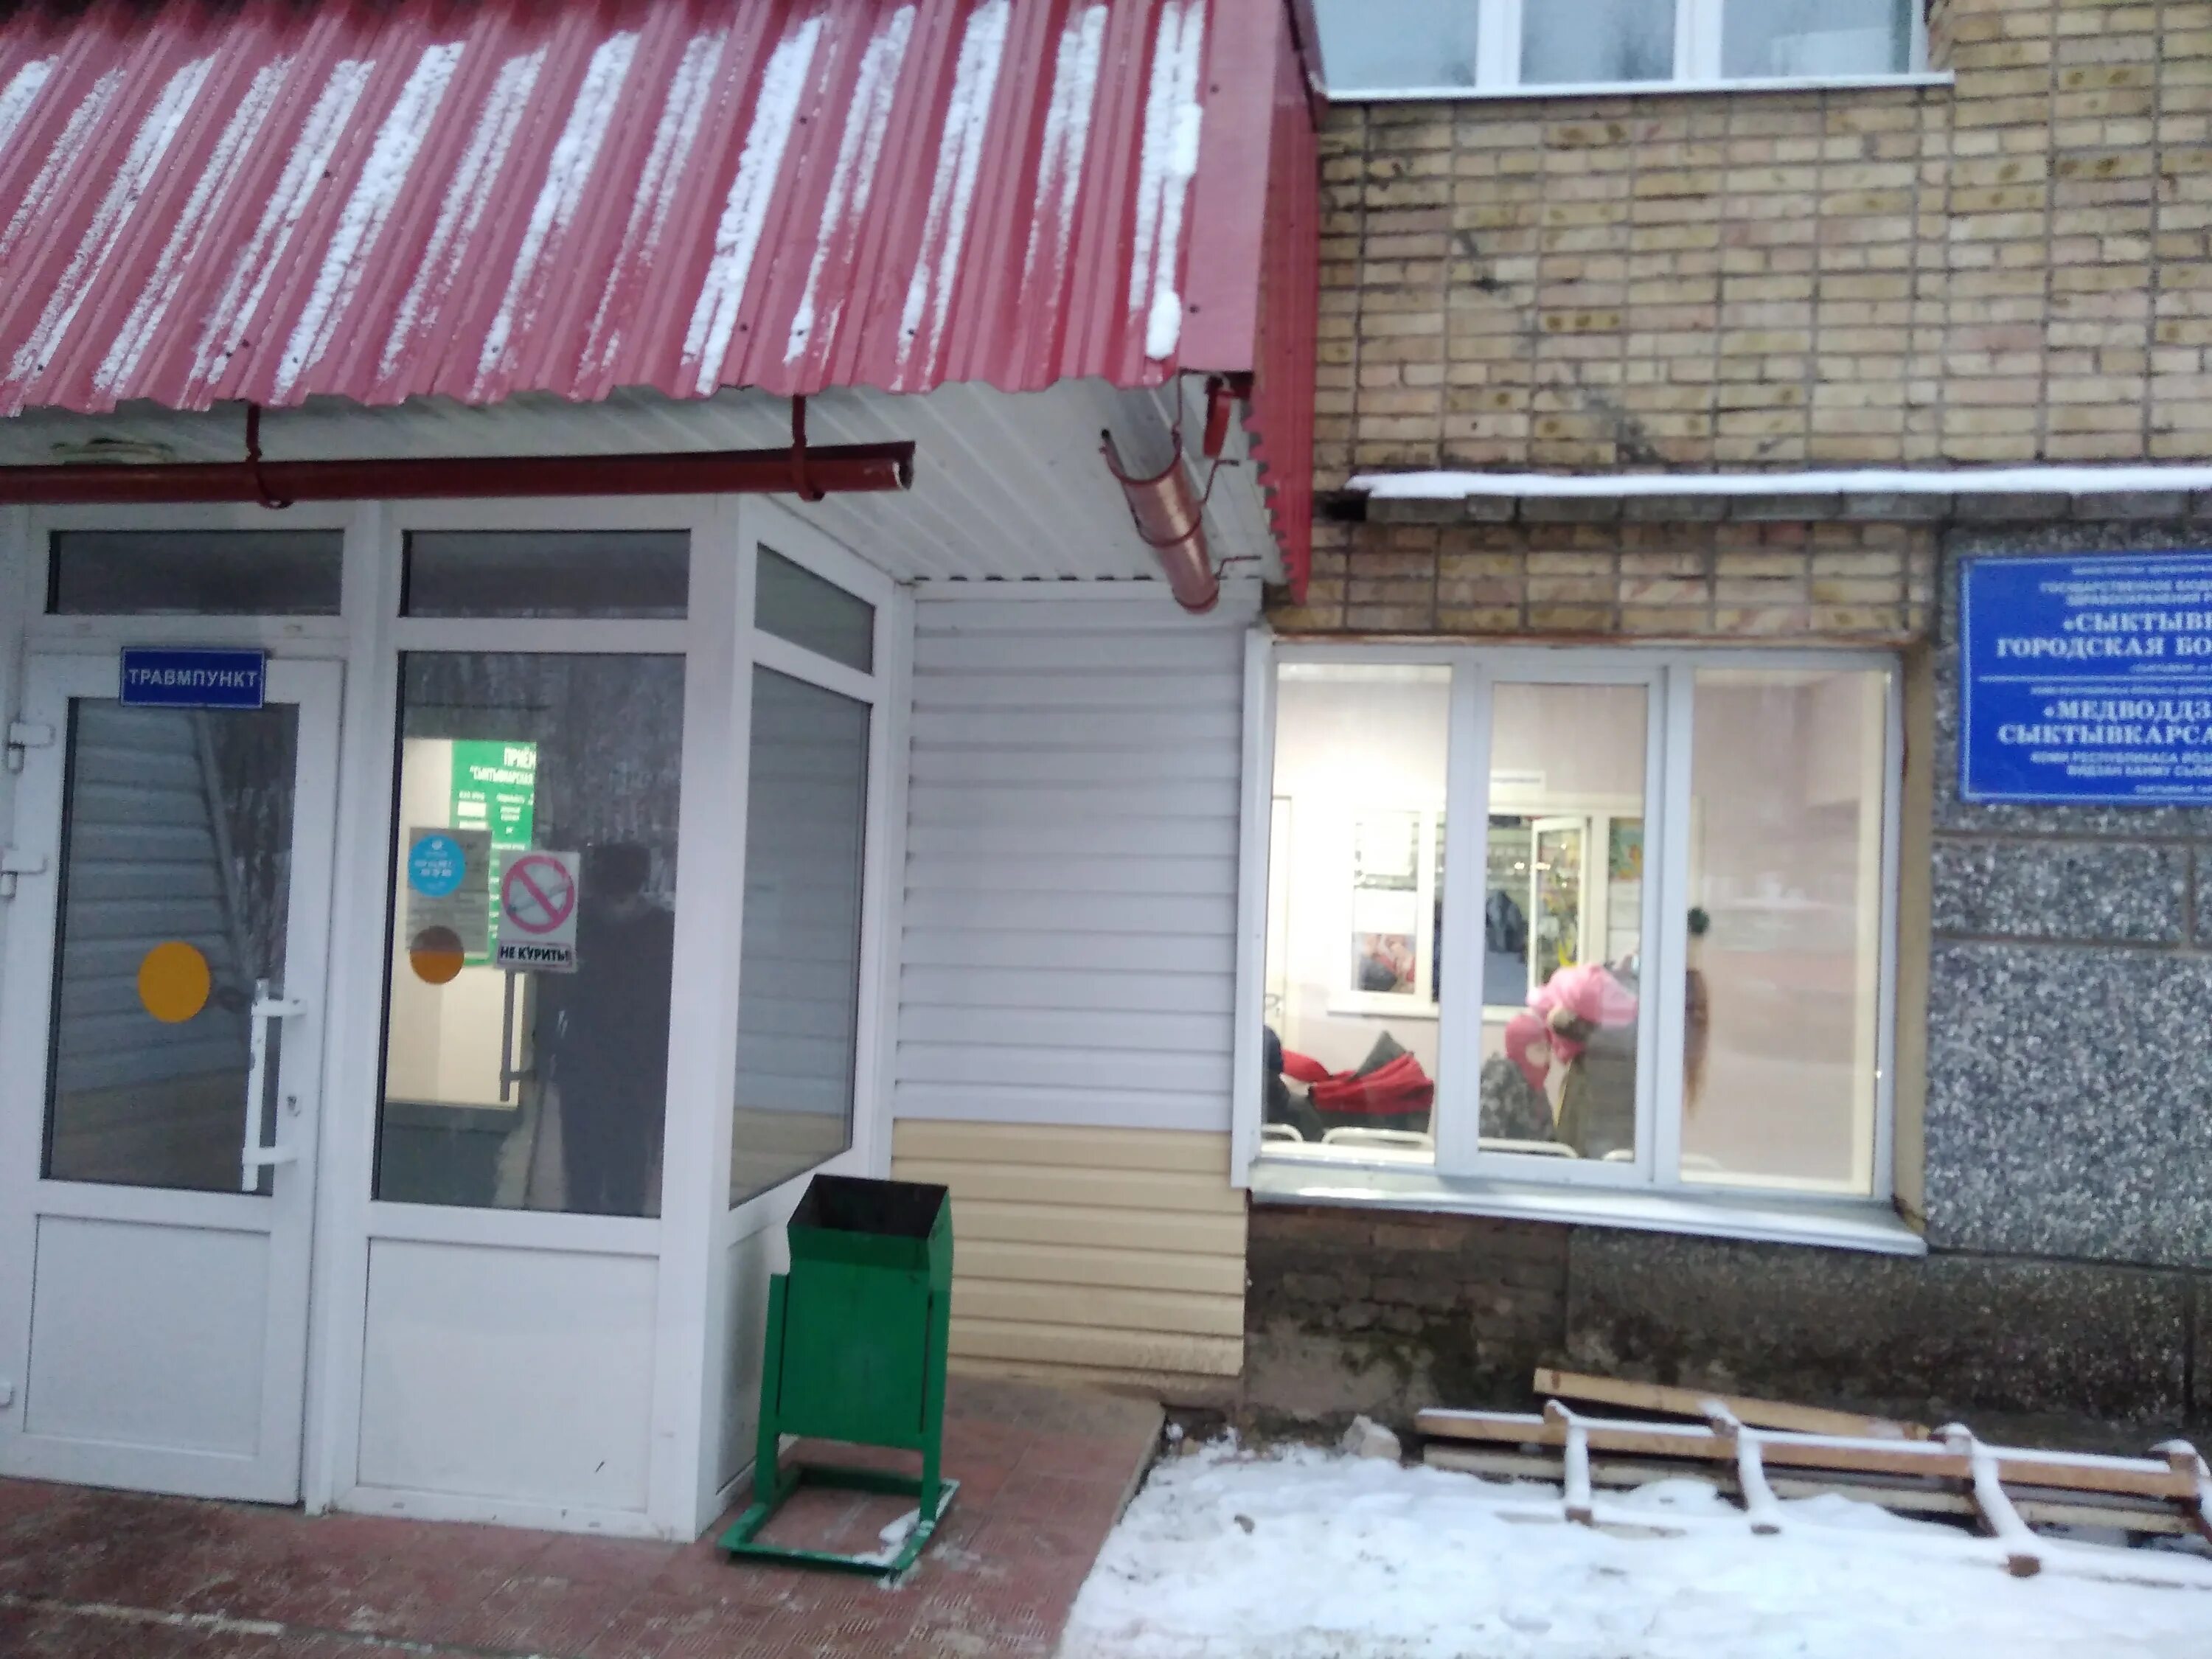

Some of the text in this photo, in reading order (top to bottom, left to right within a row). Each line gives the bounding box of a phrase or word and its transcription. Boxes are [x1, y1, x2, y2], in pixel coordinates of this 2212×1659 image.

[1997, 636, 2165, 659] ГОРОДСКАЯ
[128, 668, 258, 688] ТРАВМПУНКТ
[501, 946, 515, 959] НЕ
